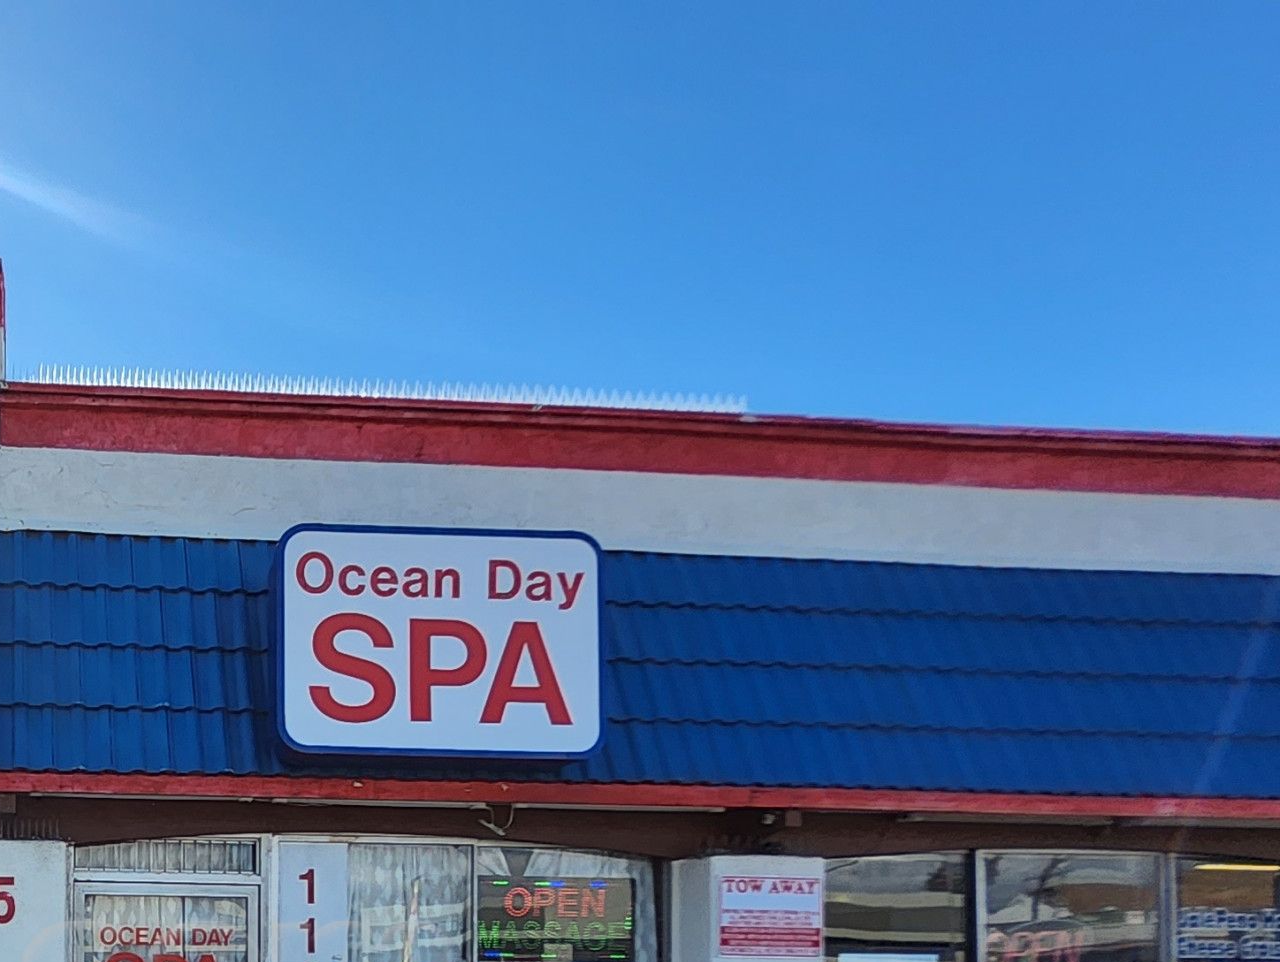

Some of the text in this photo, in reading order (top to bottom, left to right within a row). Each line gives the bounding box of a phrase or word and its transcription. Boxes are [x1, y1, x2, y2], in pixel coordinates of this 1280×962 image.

[296, 551, 586, 610] Ocean Day
[308, 612, 574, 725] SPA
[722, 879, 820, 894] TOW AWAY
[503, 887, 607, 918] OPEN
[99, 926, 234, 947] OCEAN DAY
[477, 920, 628, 951] MASSAGE
